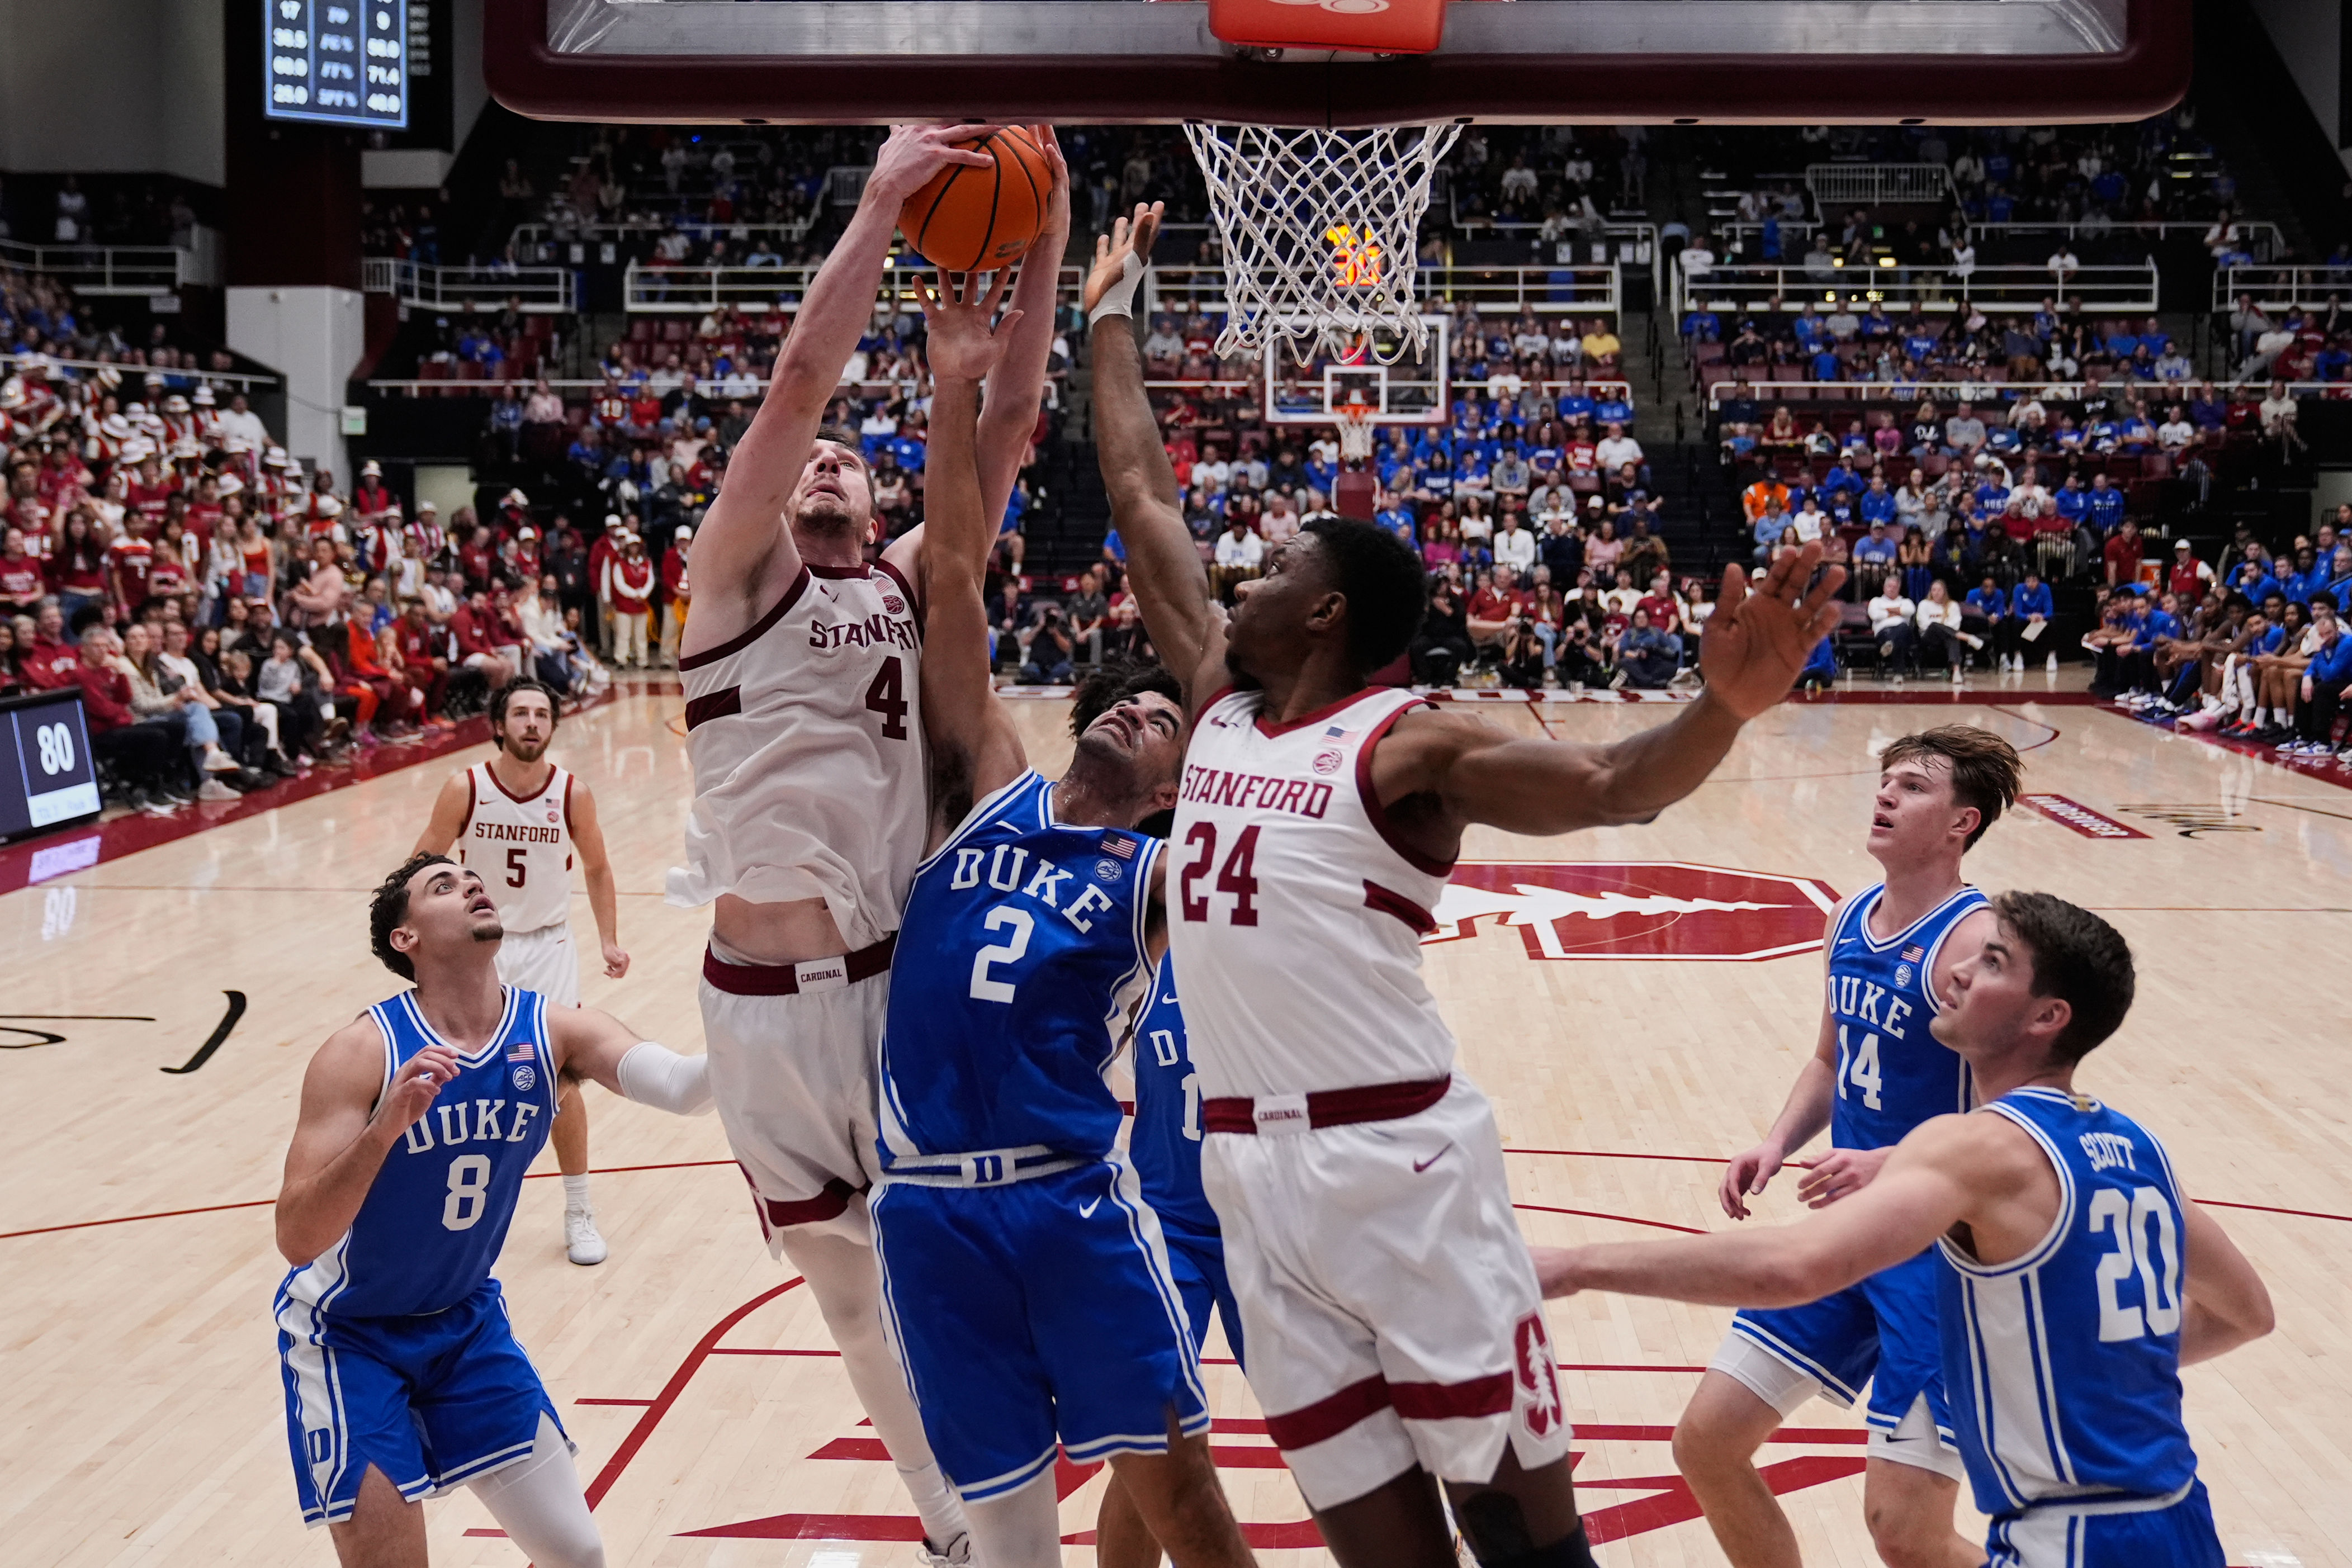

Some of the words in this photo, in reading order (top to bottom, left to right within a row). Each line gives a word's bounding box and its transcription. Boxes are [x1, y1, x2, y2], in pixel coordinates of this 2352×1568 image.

[865, 656, 907, 741] 4
[37, 722, 75, 775] 80
[1181, 764, 1333, 819] STANFORD
[475, 822, 560, 843] STANFORD
[506, 849, 527, 888] 5
[950, 845, 1113, 934] DUKE
[1181, 822, 1261, 926] 24
[801, 969, 843, 983] CARDINAL
[969, 905, 1034, 1004] 2
[1829, 975, 1913, 1040] DUKE
[1837, 1024, 1882, 1111] 14
[405, 1099, 540, 1154] DUKE
[1181, 1072, 1201, 1141] 1
[1258, 1109, 1303, 1122] CARDINAL
[2079, 1133, 2137, 1172] SCOTT
[442, 1154, 491, 1231] 8
[2089, 1186, 2181, 1342] 20
